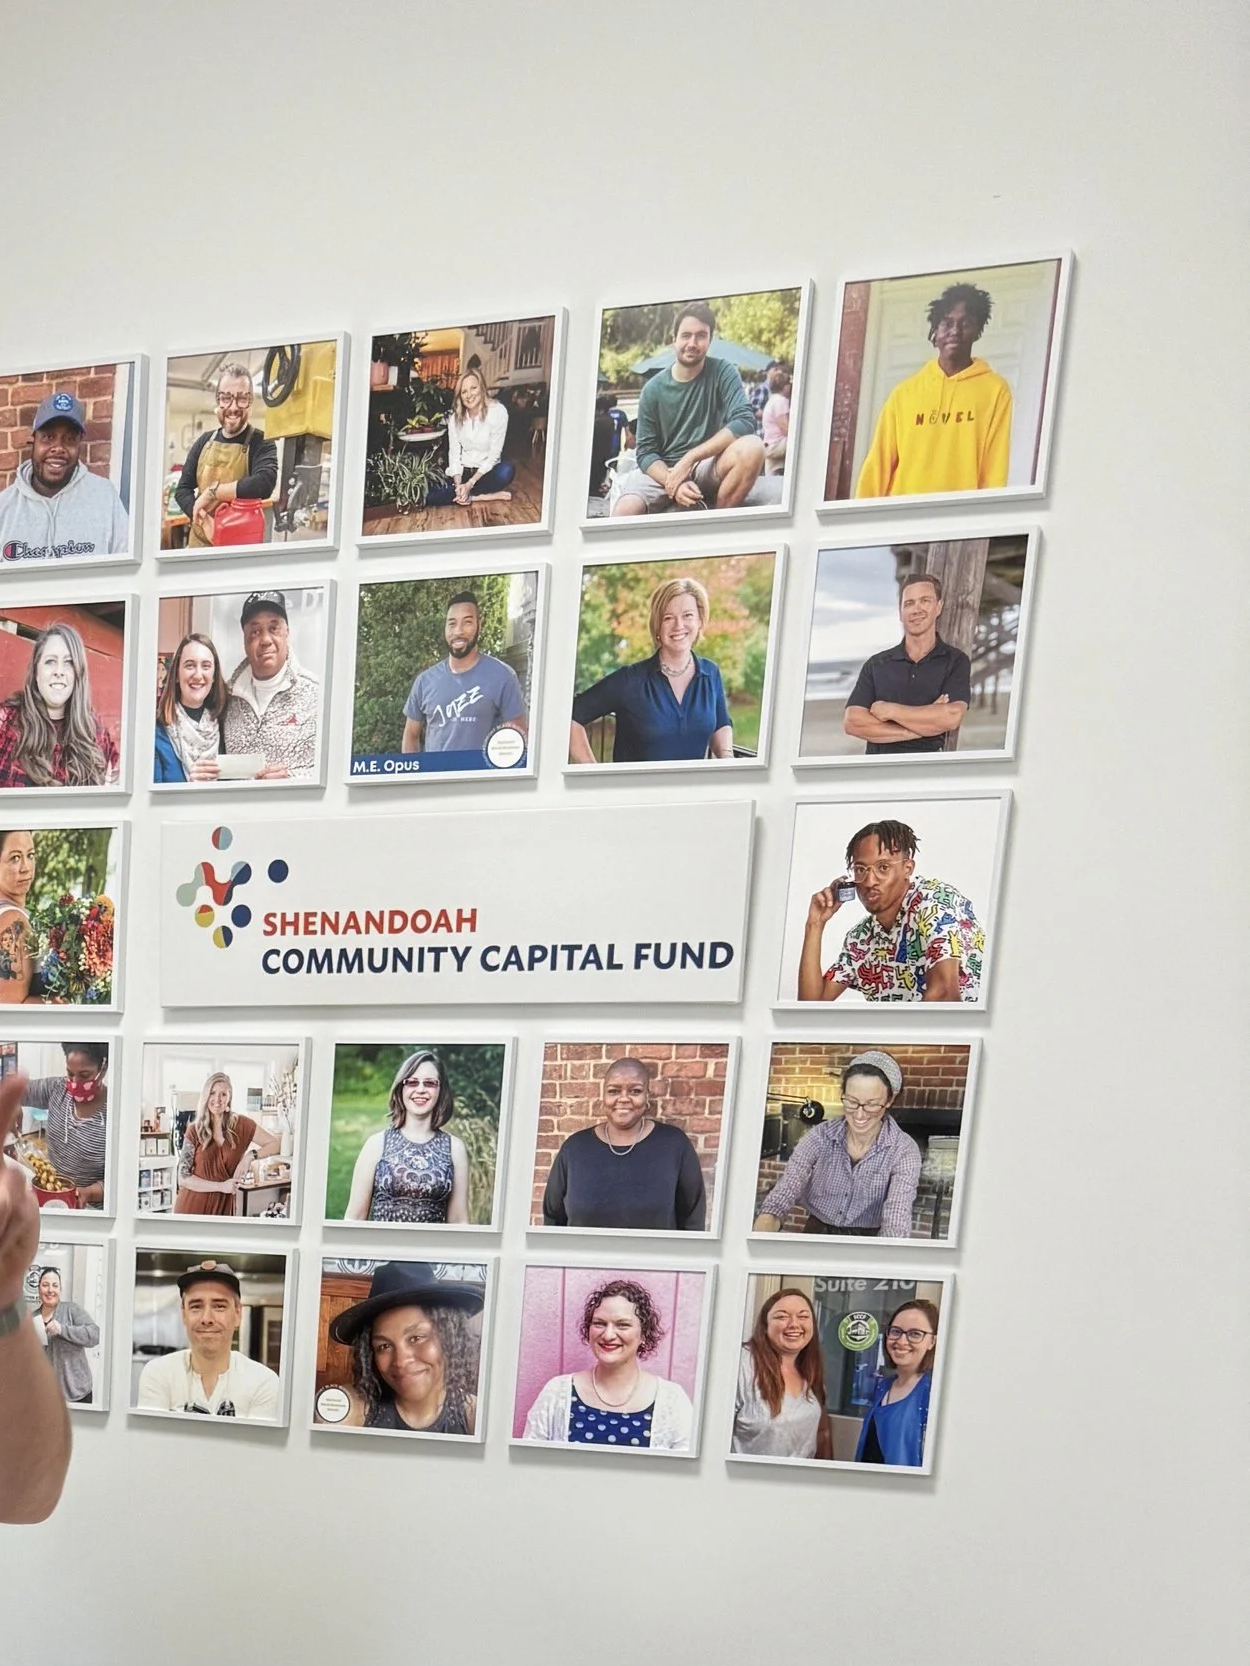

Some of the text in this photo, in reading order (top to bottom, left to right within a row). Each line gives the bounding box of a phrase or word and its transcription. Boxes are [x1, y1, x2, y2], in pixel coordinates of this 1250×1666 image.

[352, 759, 420, 774] M.E. Opus
[262, 908, 477, 937] SHENANDOAH
[261, 941, 734, 975] COMMUNITY CAPITAL FUND
